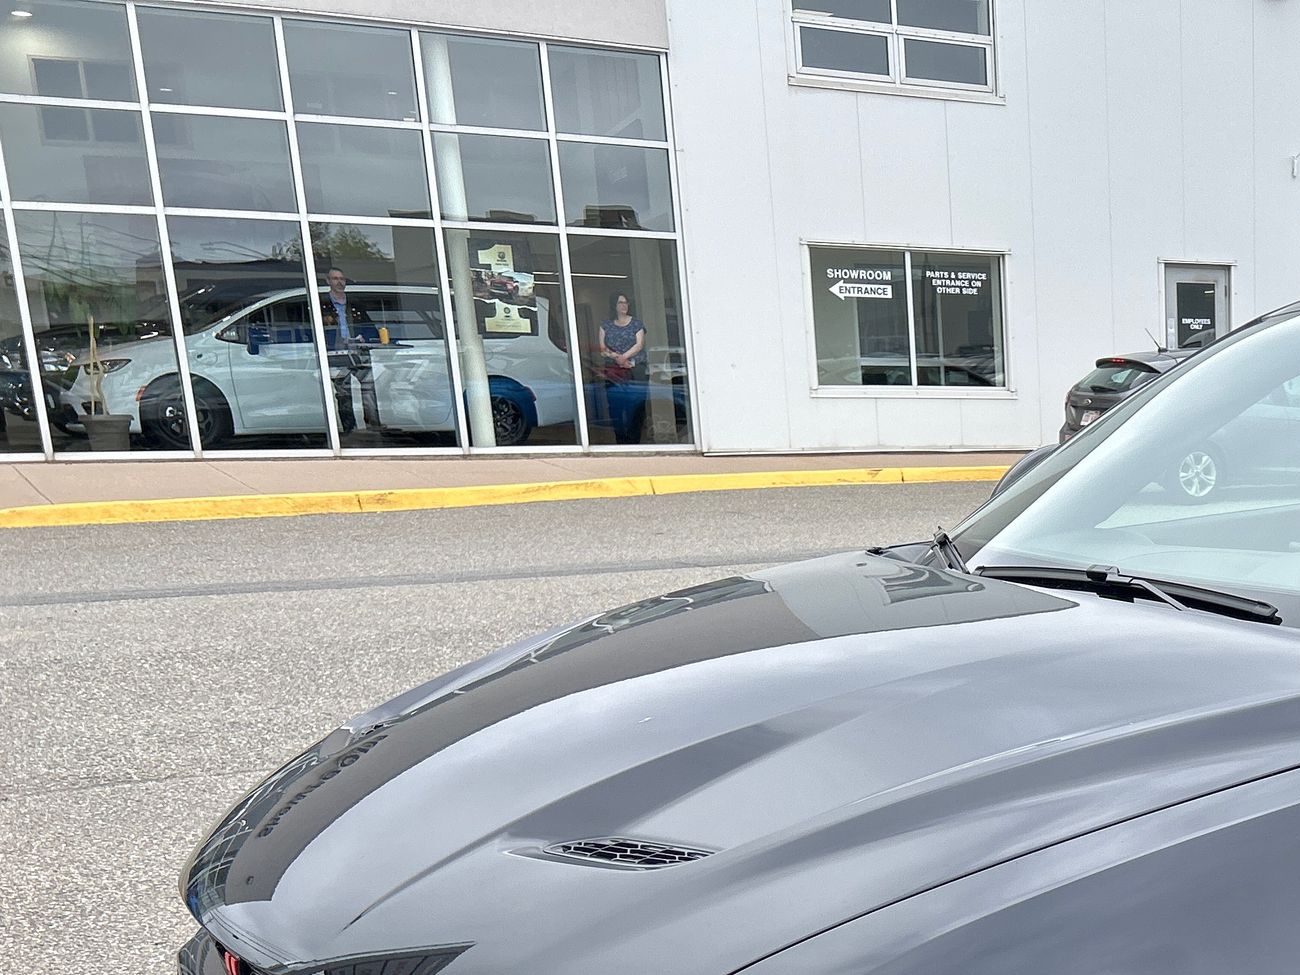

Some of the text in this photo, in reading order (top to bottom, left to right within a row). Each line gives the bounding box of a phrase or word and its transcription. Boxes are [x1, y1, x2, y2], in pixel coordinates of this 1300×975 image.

[826, 268, 892, 281] SHOWROOM
[926, 270, 987, 280] PARTS & SERVICE
[932, 278, 982, 288] ENTRANCE ON
[839, 285, 889, 296] ENTRANCE
[936, 286, 979, 295] OTHER SIDE
